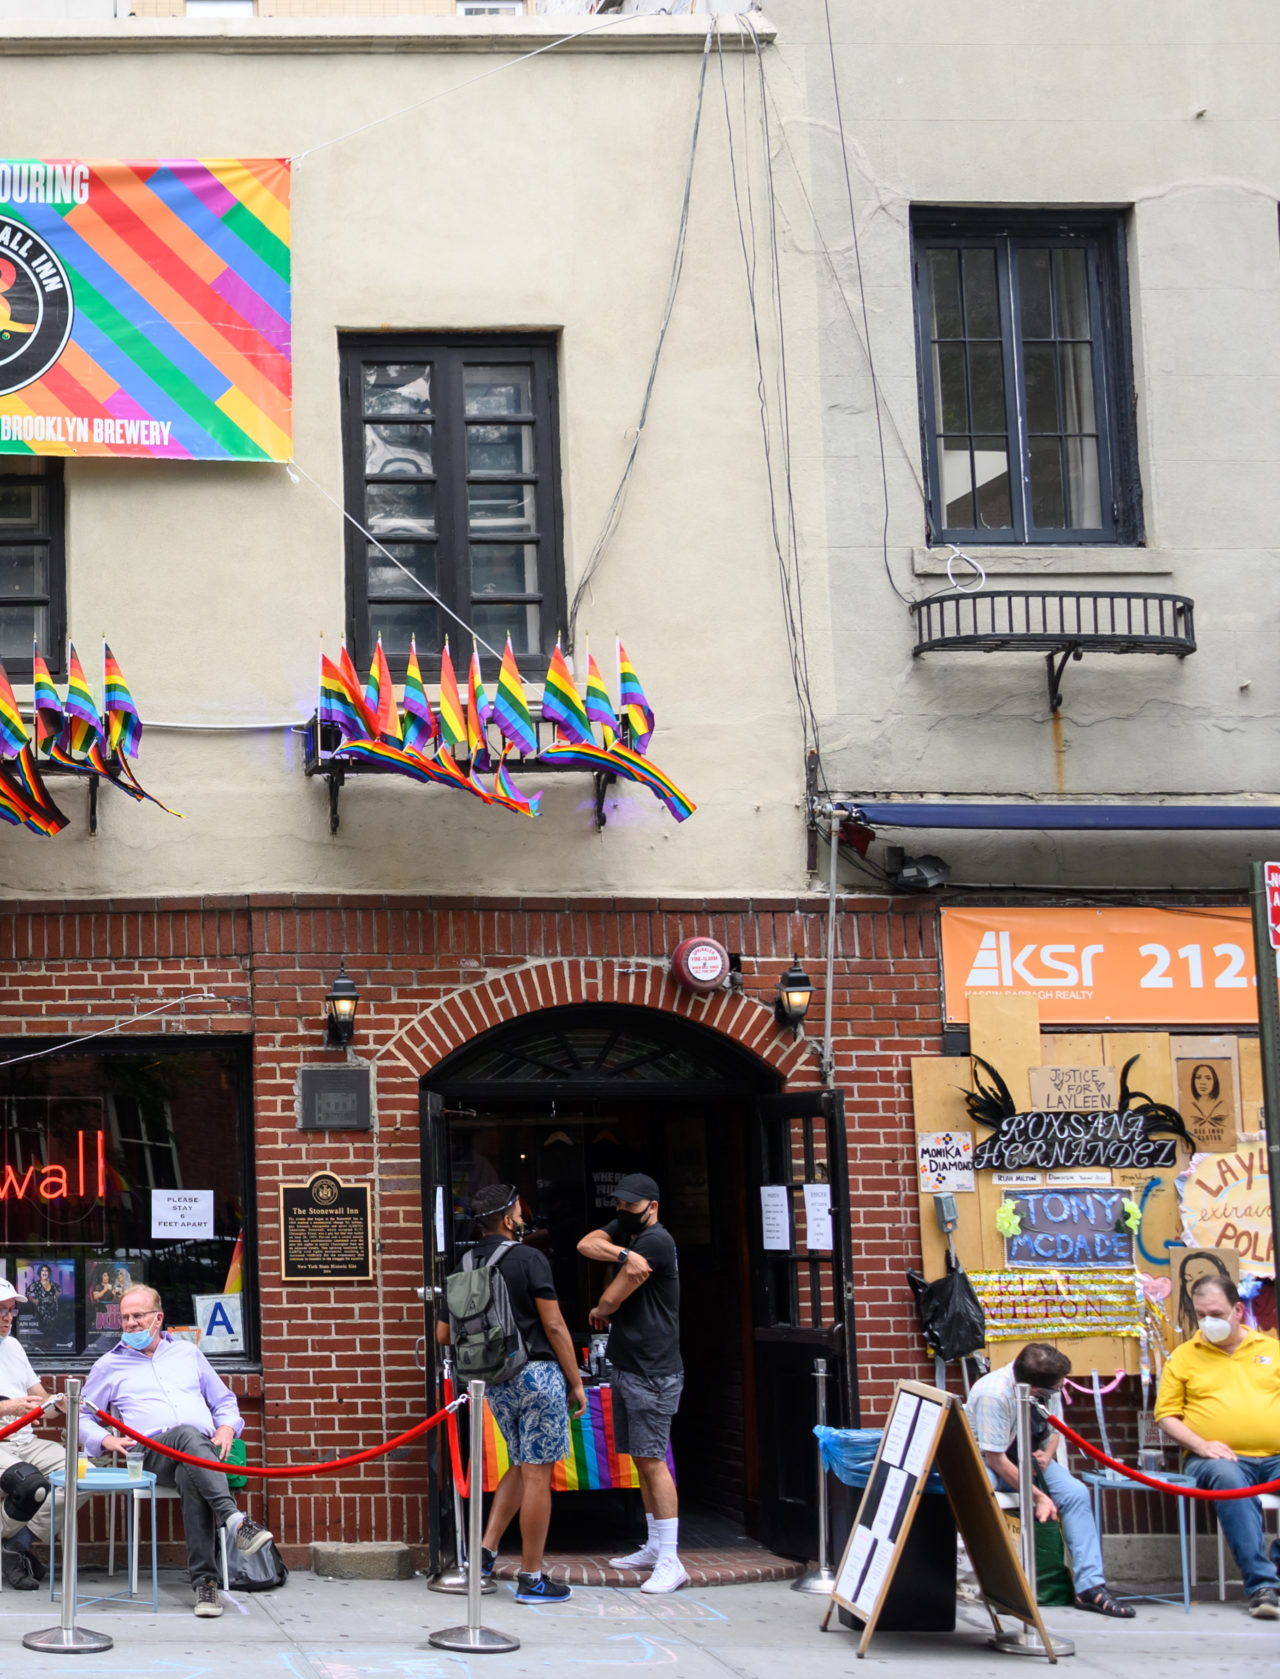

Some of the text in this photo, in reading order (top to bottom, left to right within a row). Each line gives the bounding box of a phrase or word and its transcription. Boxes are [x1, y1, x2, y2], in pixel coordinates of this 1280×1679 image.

[30, 254, 64, 293] INN
[0, 416, 89, 443] BROOKLYN
[92, 418, 172, 446] BREWERY
[1055, 991, 1094, 1000] REALTY
[1050, 1069, 1099, 1082] JUSTICE
[1067, 1084, 1092, 1093] FOR
[1046, 1093, 1111, 1109] LAYLEEN
[999, 1110, 1145, 1141] ROXSANA
[920, 1145, 962, 1159] MONIKA
[974, 1139, 1177, 1169] HERNANDEZ
[928, 1159, 974, 1173] DIAMOND
[1195, 1147, 1268, 1198] LAYL
[292, 1207, 359, 1215] The Stonewall Inn
[1016, 1193, 1120, 1225] TONY
[1010, 1233, 1129, 1261] MCDADE
[998, 1275, 1073, 1296] RIAH
[206, 1302, 235, 1336] A
[981, 1299, 1104, 1319] MILTON
